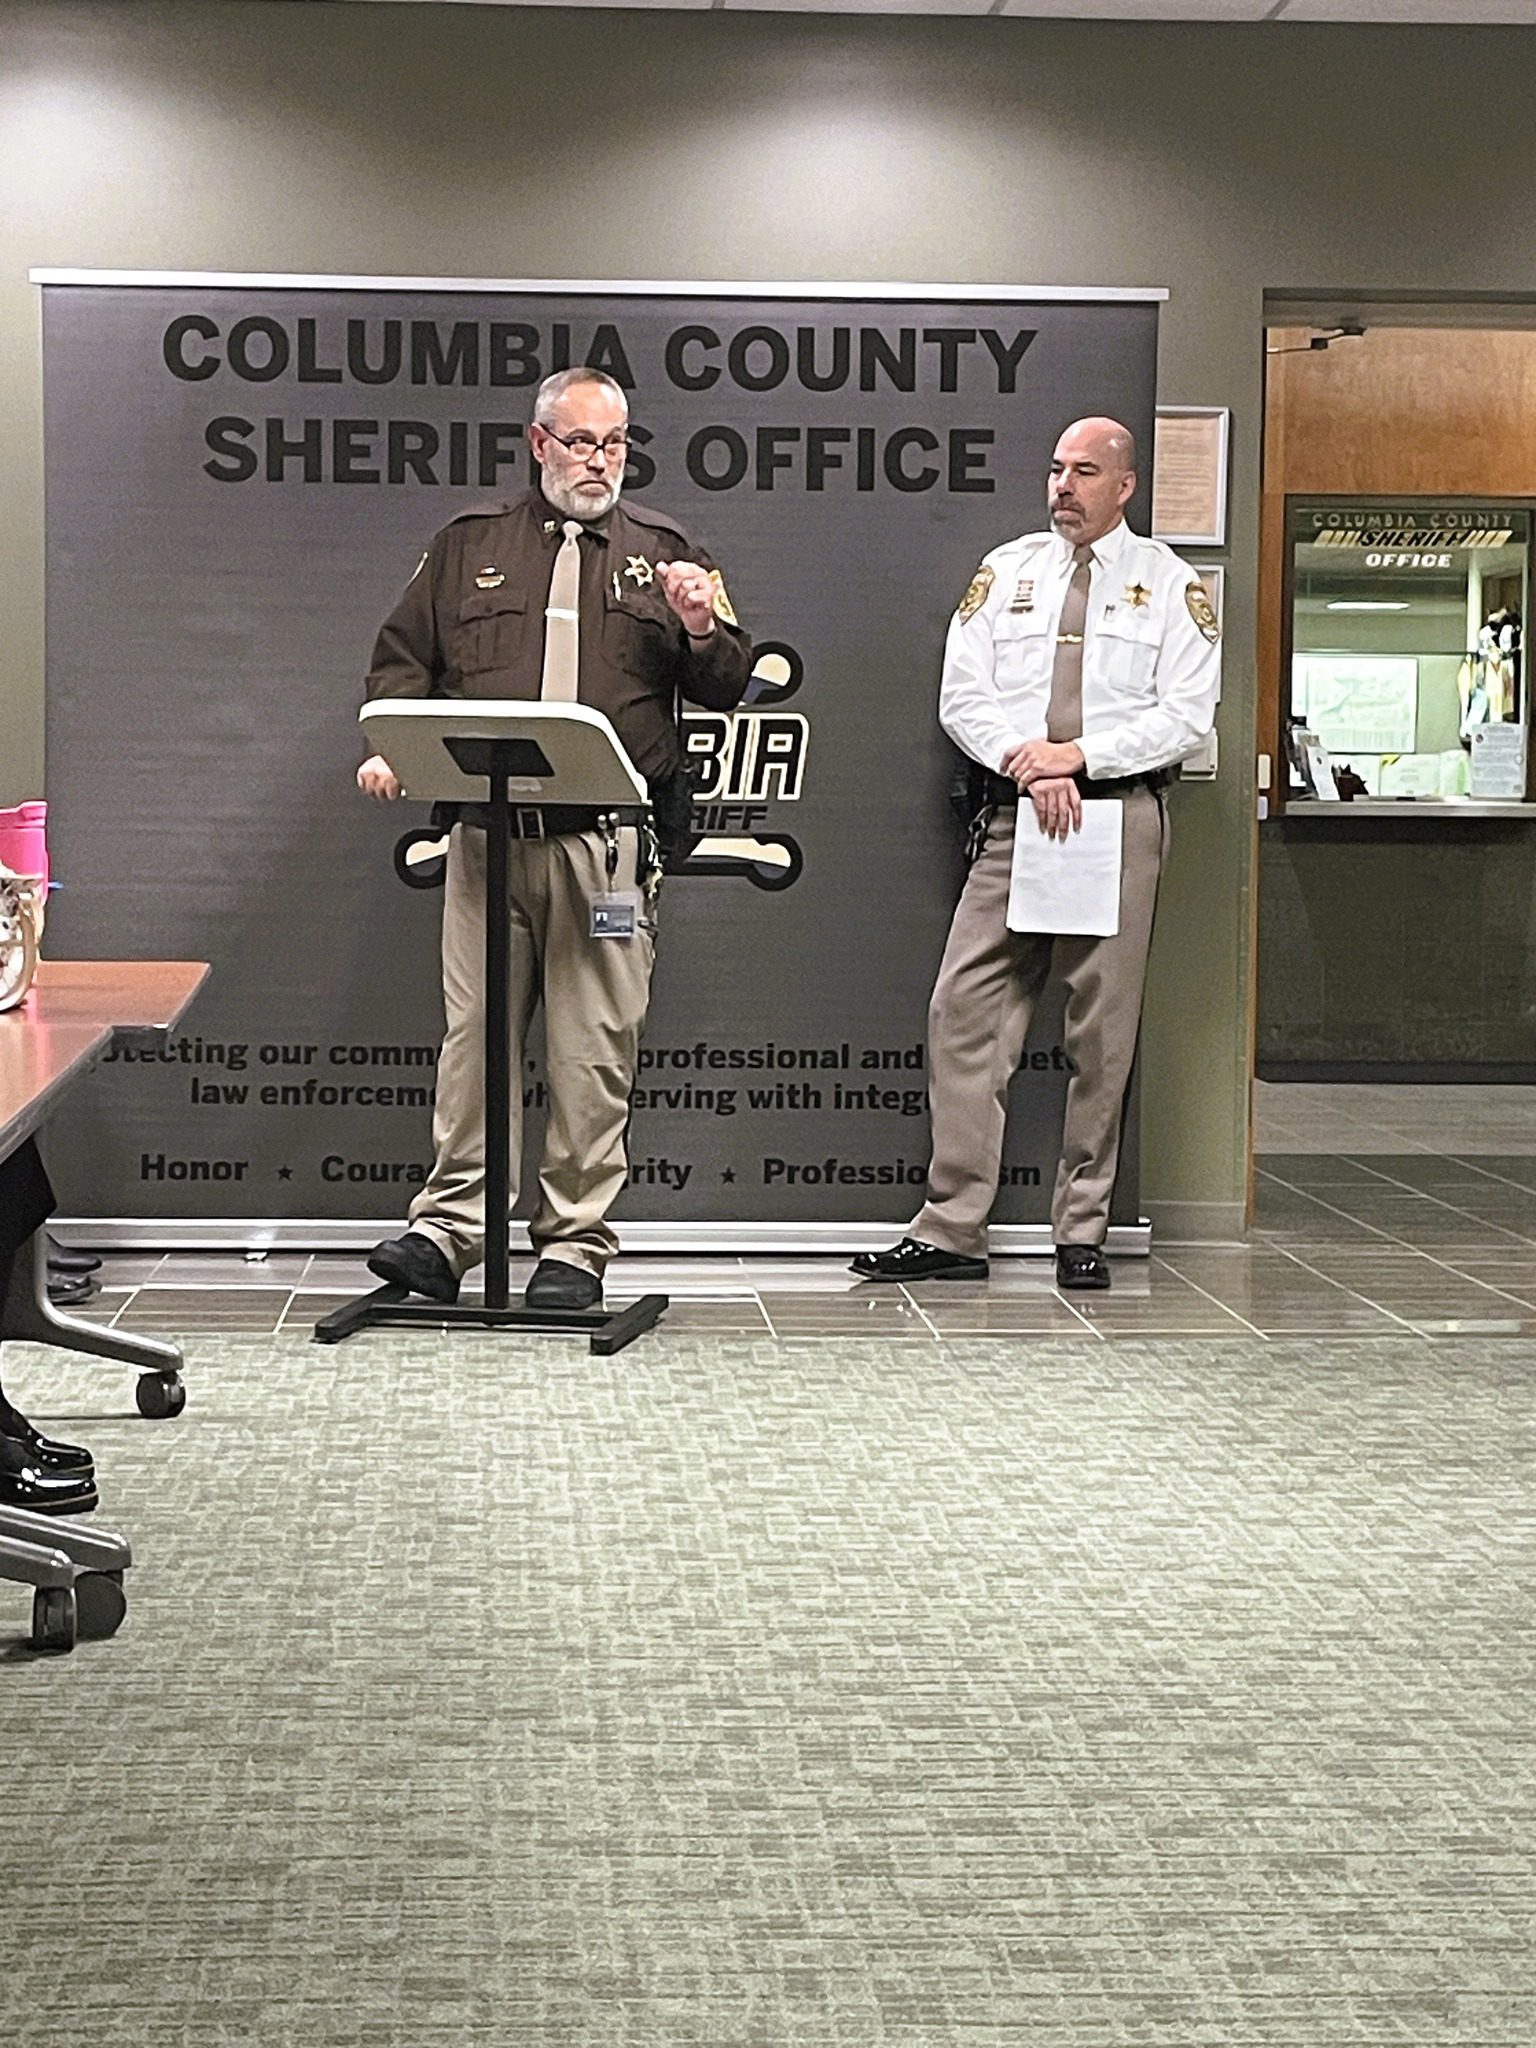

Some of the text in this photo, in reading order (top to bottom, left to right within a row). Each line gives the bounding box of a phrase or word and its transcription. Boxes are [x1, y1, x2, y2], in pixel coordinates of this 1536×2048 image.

[163, 315, 1038, 394] COLUMBIA COUNTY
[202, 416, 996, 493] SHERIFS OFFICE
[1312, 513, 1513, 528] COLUMBIA COUNTY
[1360, 530, 1470, 547] SHERIFF
[1365, 553, 1453, 568] OFFICE
[691, 805, 768, 830] RIFF
[259, 1045, 318, 1066] our
[636, 1043, 849, 1075] professional
[860, 1044, 924, 1070] and
[191, 1077, 930, 1116] law enforcem erving with integ
[140, 1154, 249, 1181] Honor
[321, 1155, 428, 1184] Coura
